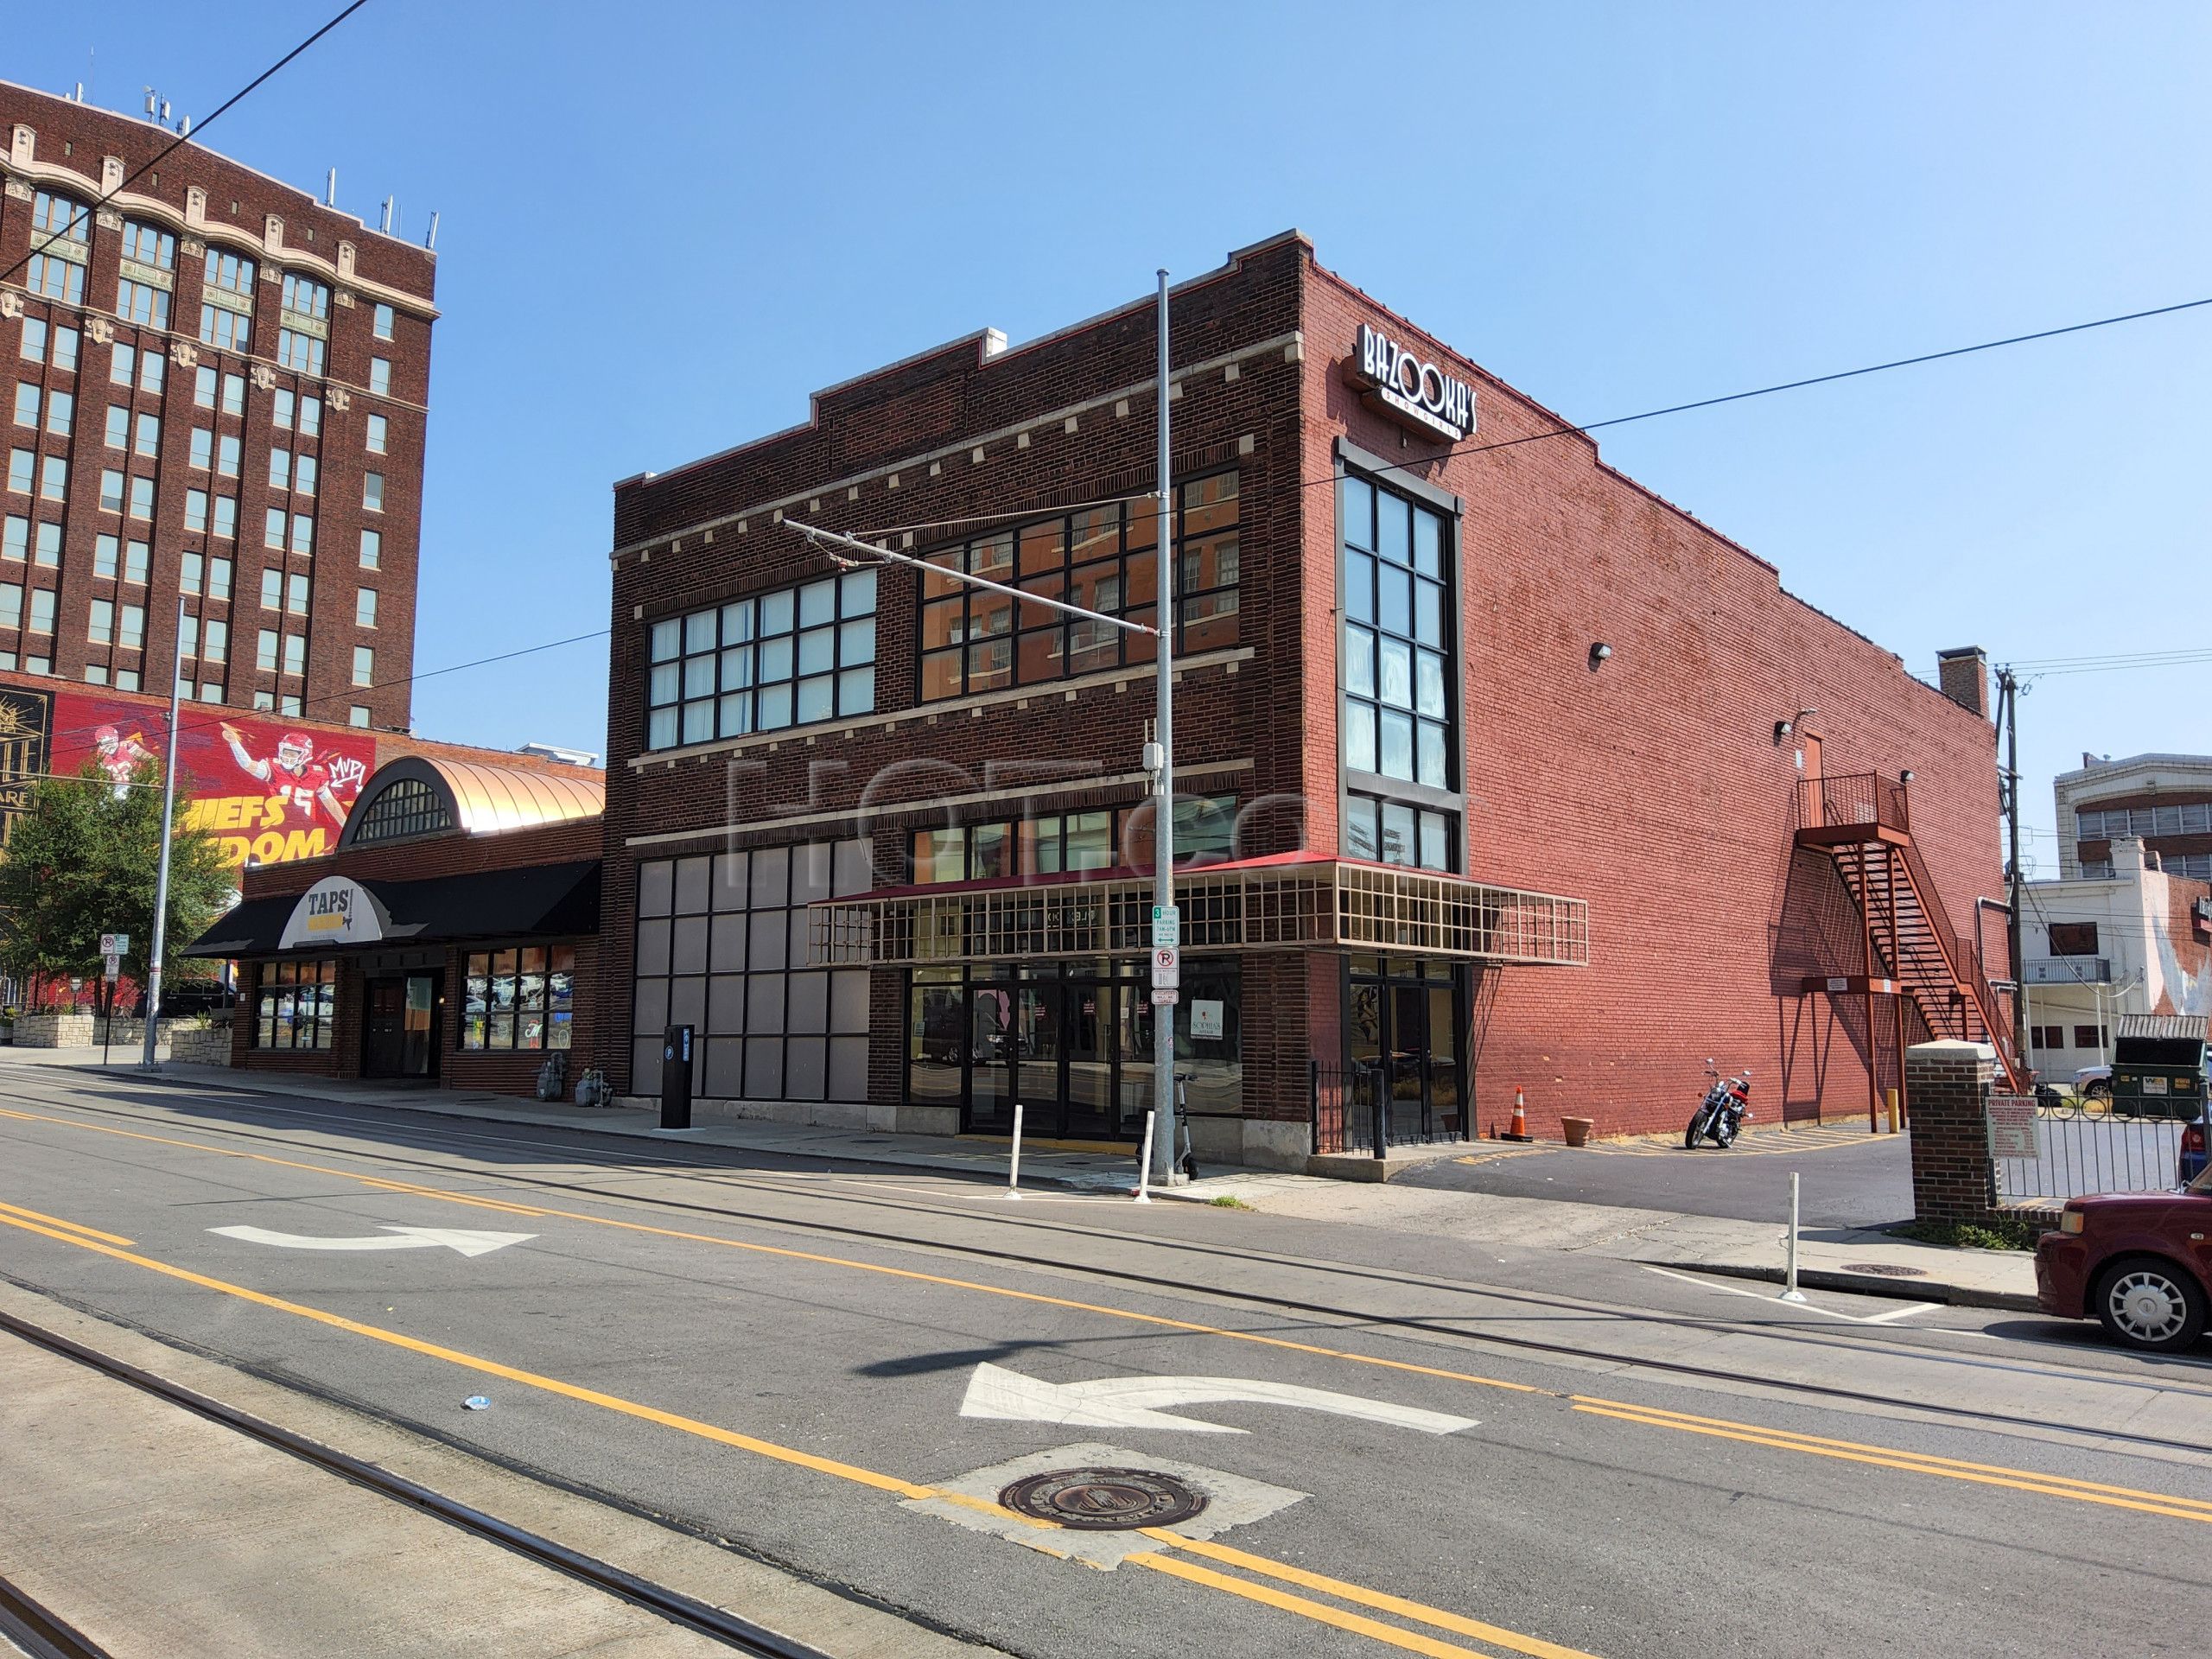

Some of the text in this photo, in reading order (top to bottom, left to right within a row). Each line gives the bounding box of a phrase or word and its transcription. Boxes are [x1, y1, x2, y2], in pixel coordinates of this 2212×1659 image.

[1363, 323, 1477, 434] BAZOOKA'S
[1385, 391, 1460, 438] SHOWGIRLS
[1154, 908, 1160, 918] 3
